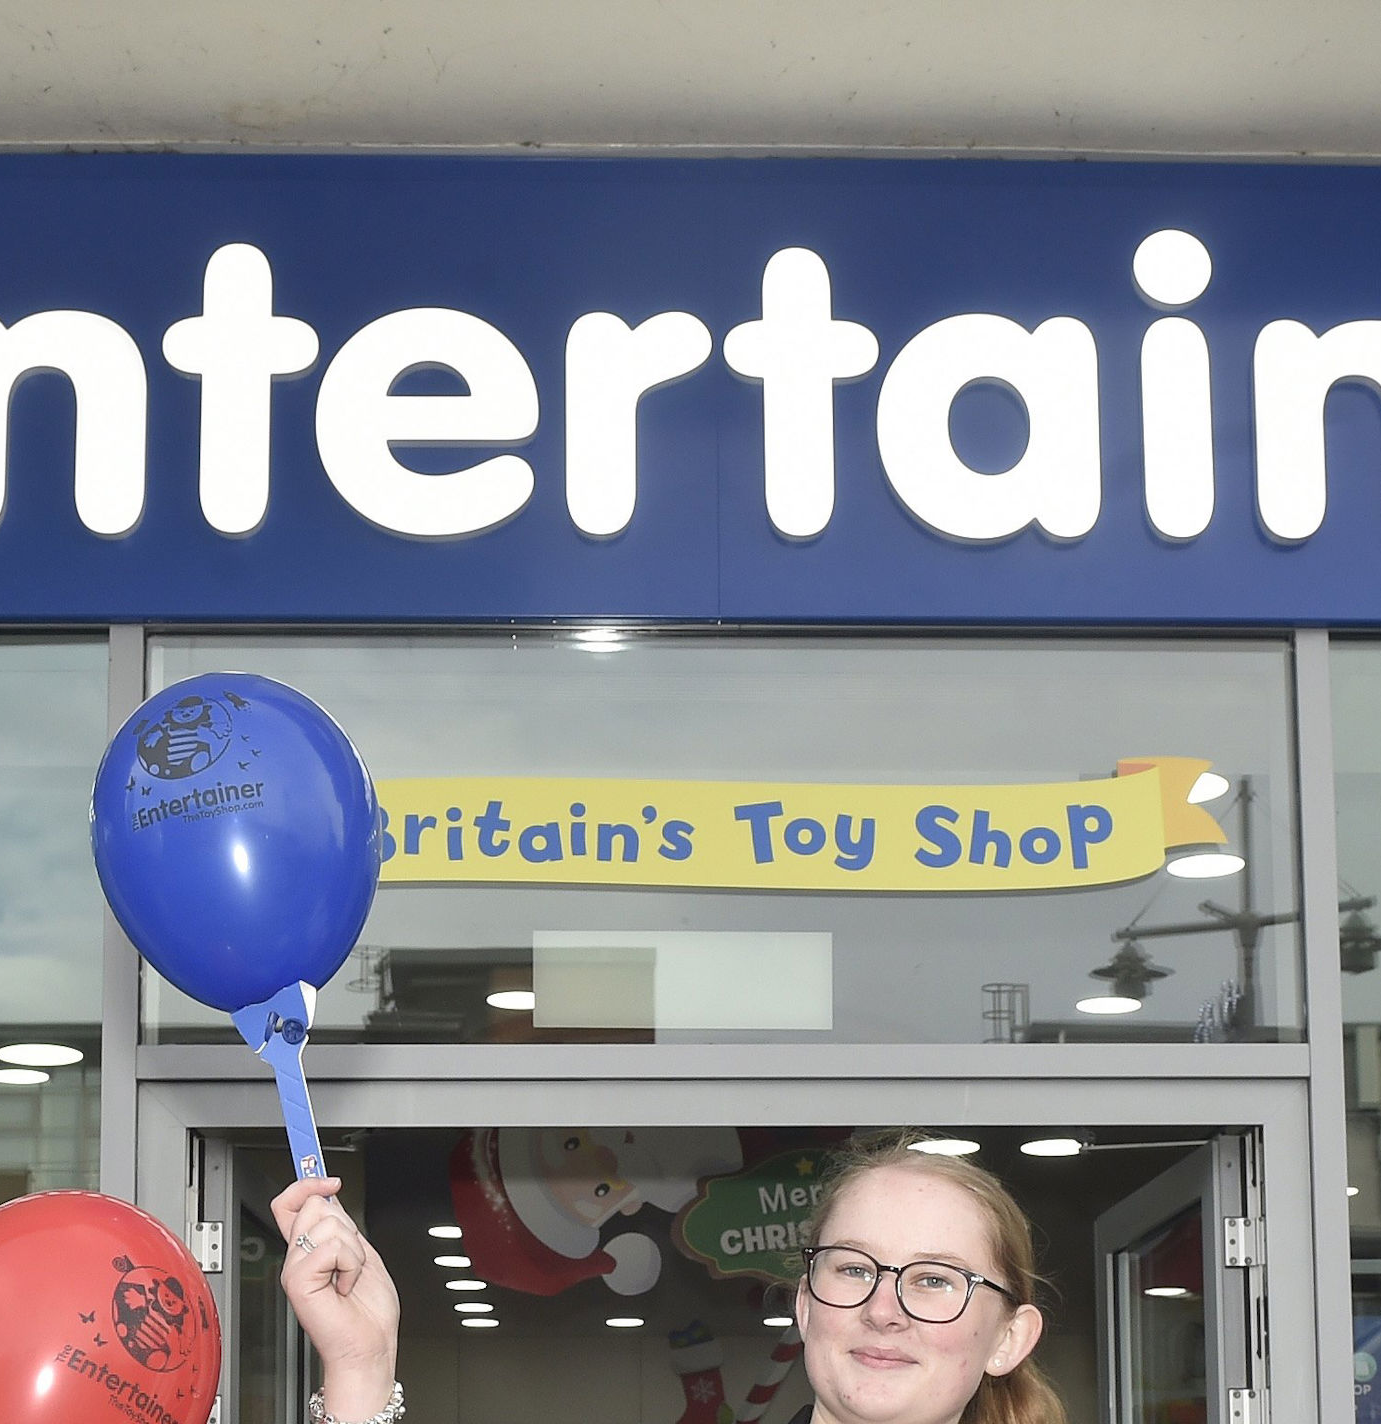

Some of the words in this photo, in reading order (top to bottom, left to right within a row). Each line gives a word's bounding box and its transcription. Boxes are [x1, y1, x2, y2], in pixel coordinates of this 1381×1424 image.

[138, 781, 264, 829] Entertainer
[182, 801, 264, 824] TheToyShop.com
[733, 801, 877, 872] Toy
[913, 804, 1115, 871] Shop
[757, 1182, 824, 1215] Mer
[719, 1220, 813, 1256] CHRIS
